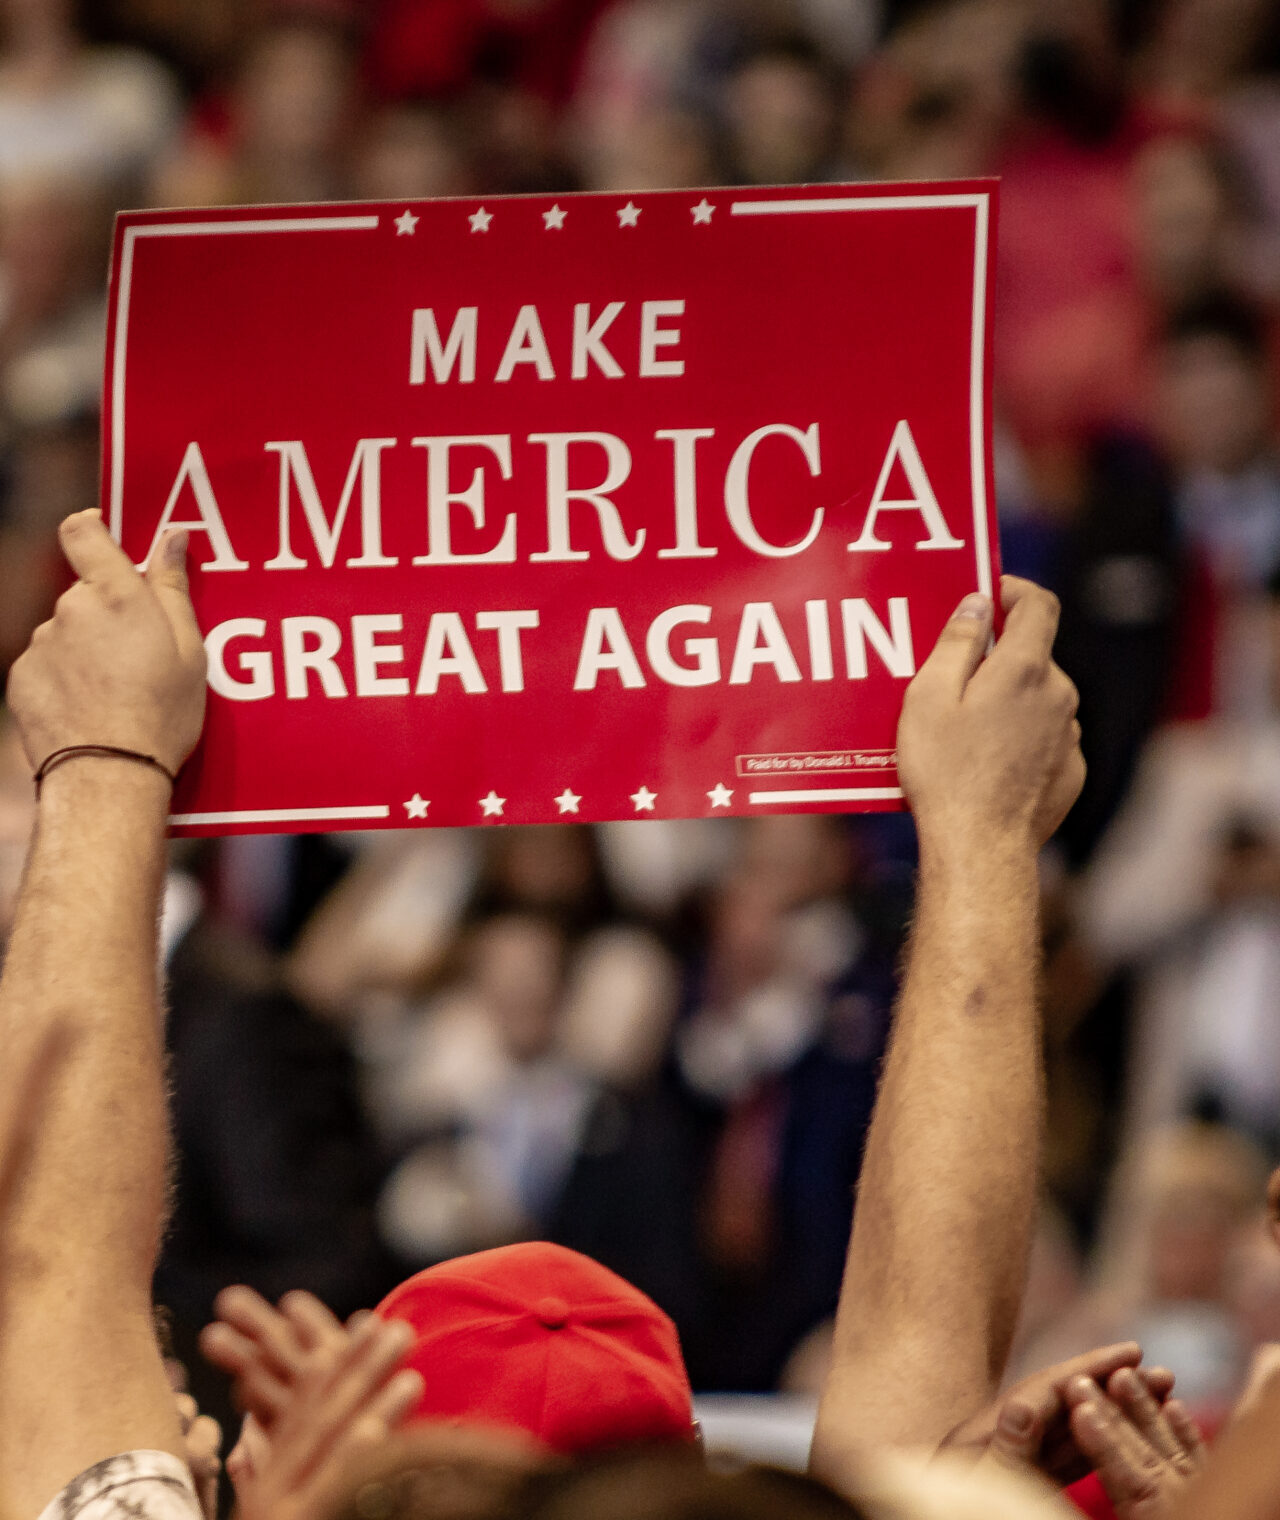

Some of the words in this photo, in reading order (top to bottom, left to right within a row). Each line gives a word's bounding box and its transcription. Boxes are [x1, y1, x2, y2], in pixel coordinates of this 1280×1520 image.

[409, 299, 686, 385] MAKE
[134, 420, 965, 572] AMERICA
[204, 609, 540, 701] GREAT
[574, 597, 916, 691] AGAIN
[746, 757, 771, 770] Paid
[772, 756, 789, 769] for
[789, 756, 804, 770] by
[804, 754, 844, 768] Donald
[853, 753, 889, 768] Trump
